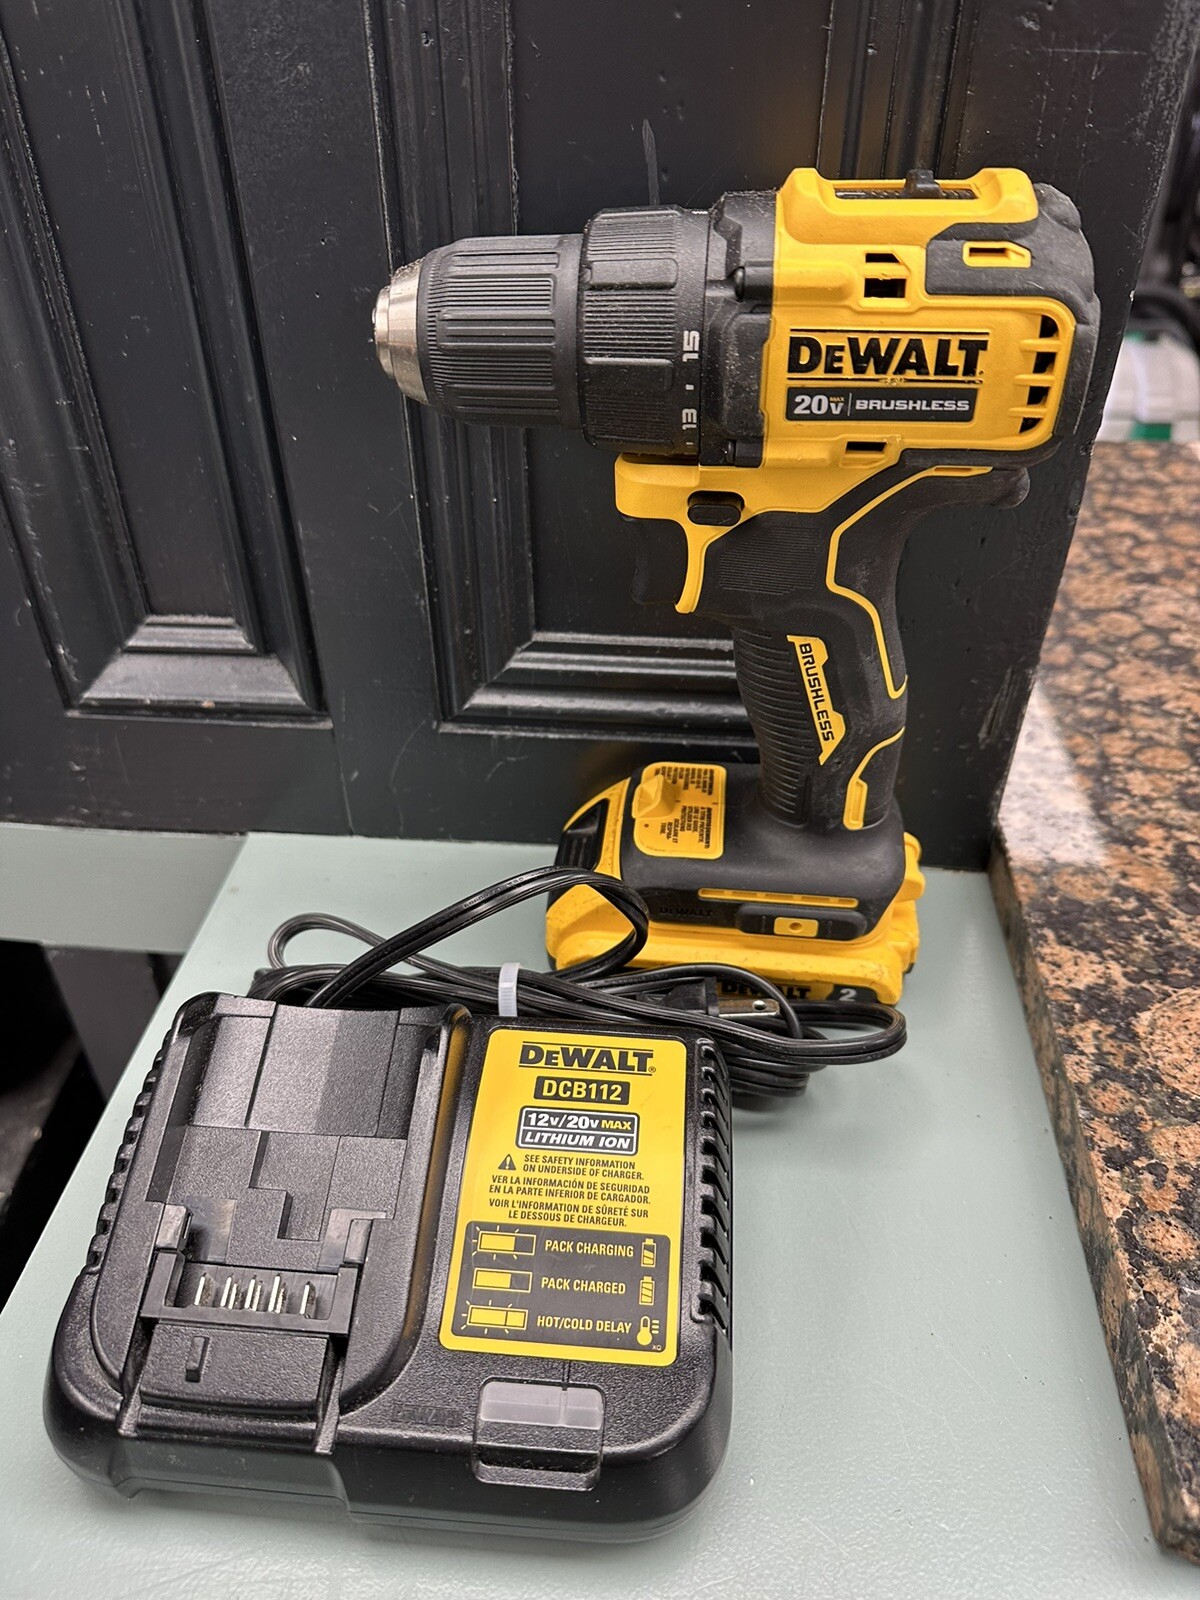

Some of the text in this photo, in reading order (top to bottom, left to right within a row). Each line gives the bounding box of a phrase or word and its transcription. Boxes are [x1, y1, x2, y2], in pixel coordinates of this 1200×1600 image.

[683, 331, 700, 362] 15
[787, 336, 988, 377] DEWALT
[855, 399, 970, 411] BRUSHLESS
[682, 408, 698, 430] 13
[799, 643, 835, 741] BRUSHLESS
[838, 988, 857, 1001] 2
[542, 1080, 622, 1101] DCB112
[601, 1119, 632, 1130] MAX
[524, 1131, 631, 1149] LITHIUM ION
[524, 1154, 635, 1169] SEE SAFETY INFORMATION
[523, 1164, 644, 1180] ON UNDERSIDE OF CHARGER.
[492, 1175, 650, 1194] VER LA INFORMACIÓN DE SEGURIDAD
[489, 1184, 651, 1204] EN LA PARTE INFERIOR DE CARGADOR.
[489, 1198, 649, 1218] VOIR L'INFORMATION DE SÛRETÉ SUR
[508, 1210, 627, 1227] LE DESSOUS DE CHARGEUR.
[545, 1239, 634, 1257] PACK CHARGING
[541, 1277, 626, 1294] PACK CHARGED
[537, 1315, 632, 1334] HOT/COLD DELAY
